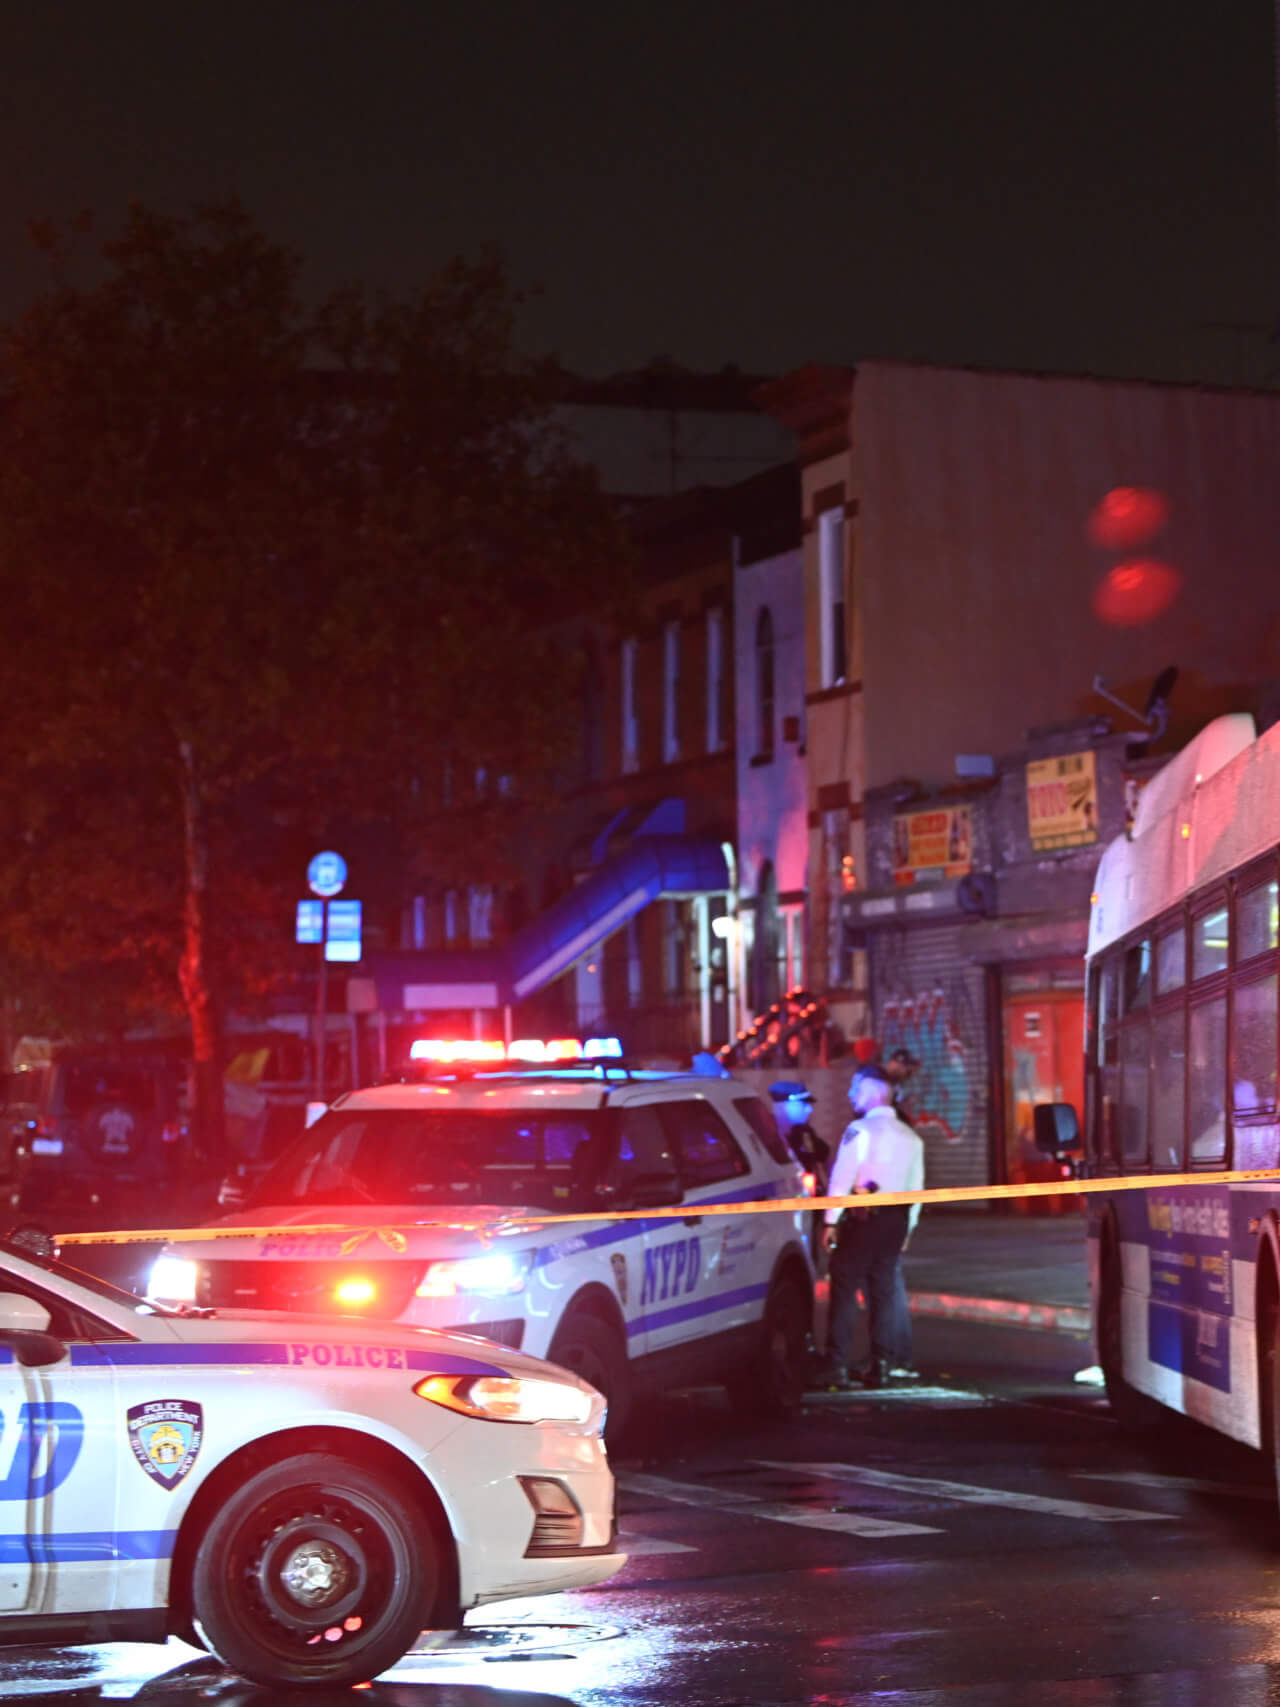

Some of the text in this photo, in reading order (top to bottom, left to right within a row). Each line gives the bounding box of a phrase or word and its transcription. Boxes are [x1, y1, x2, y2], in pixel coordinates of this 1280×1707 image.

[640, 1236, 700, 1307] NYPD
[289, 1343, 405, 1370] POLICE
[143, 1402, 184, 1415] POLICE
[129, 1410, 201, 1432] DEPARTMENT
